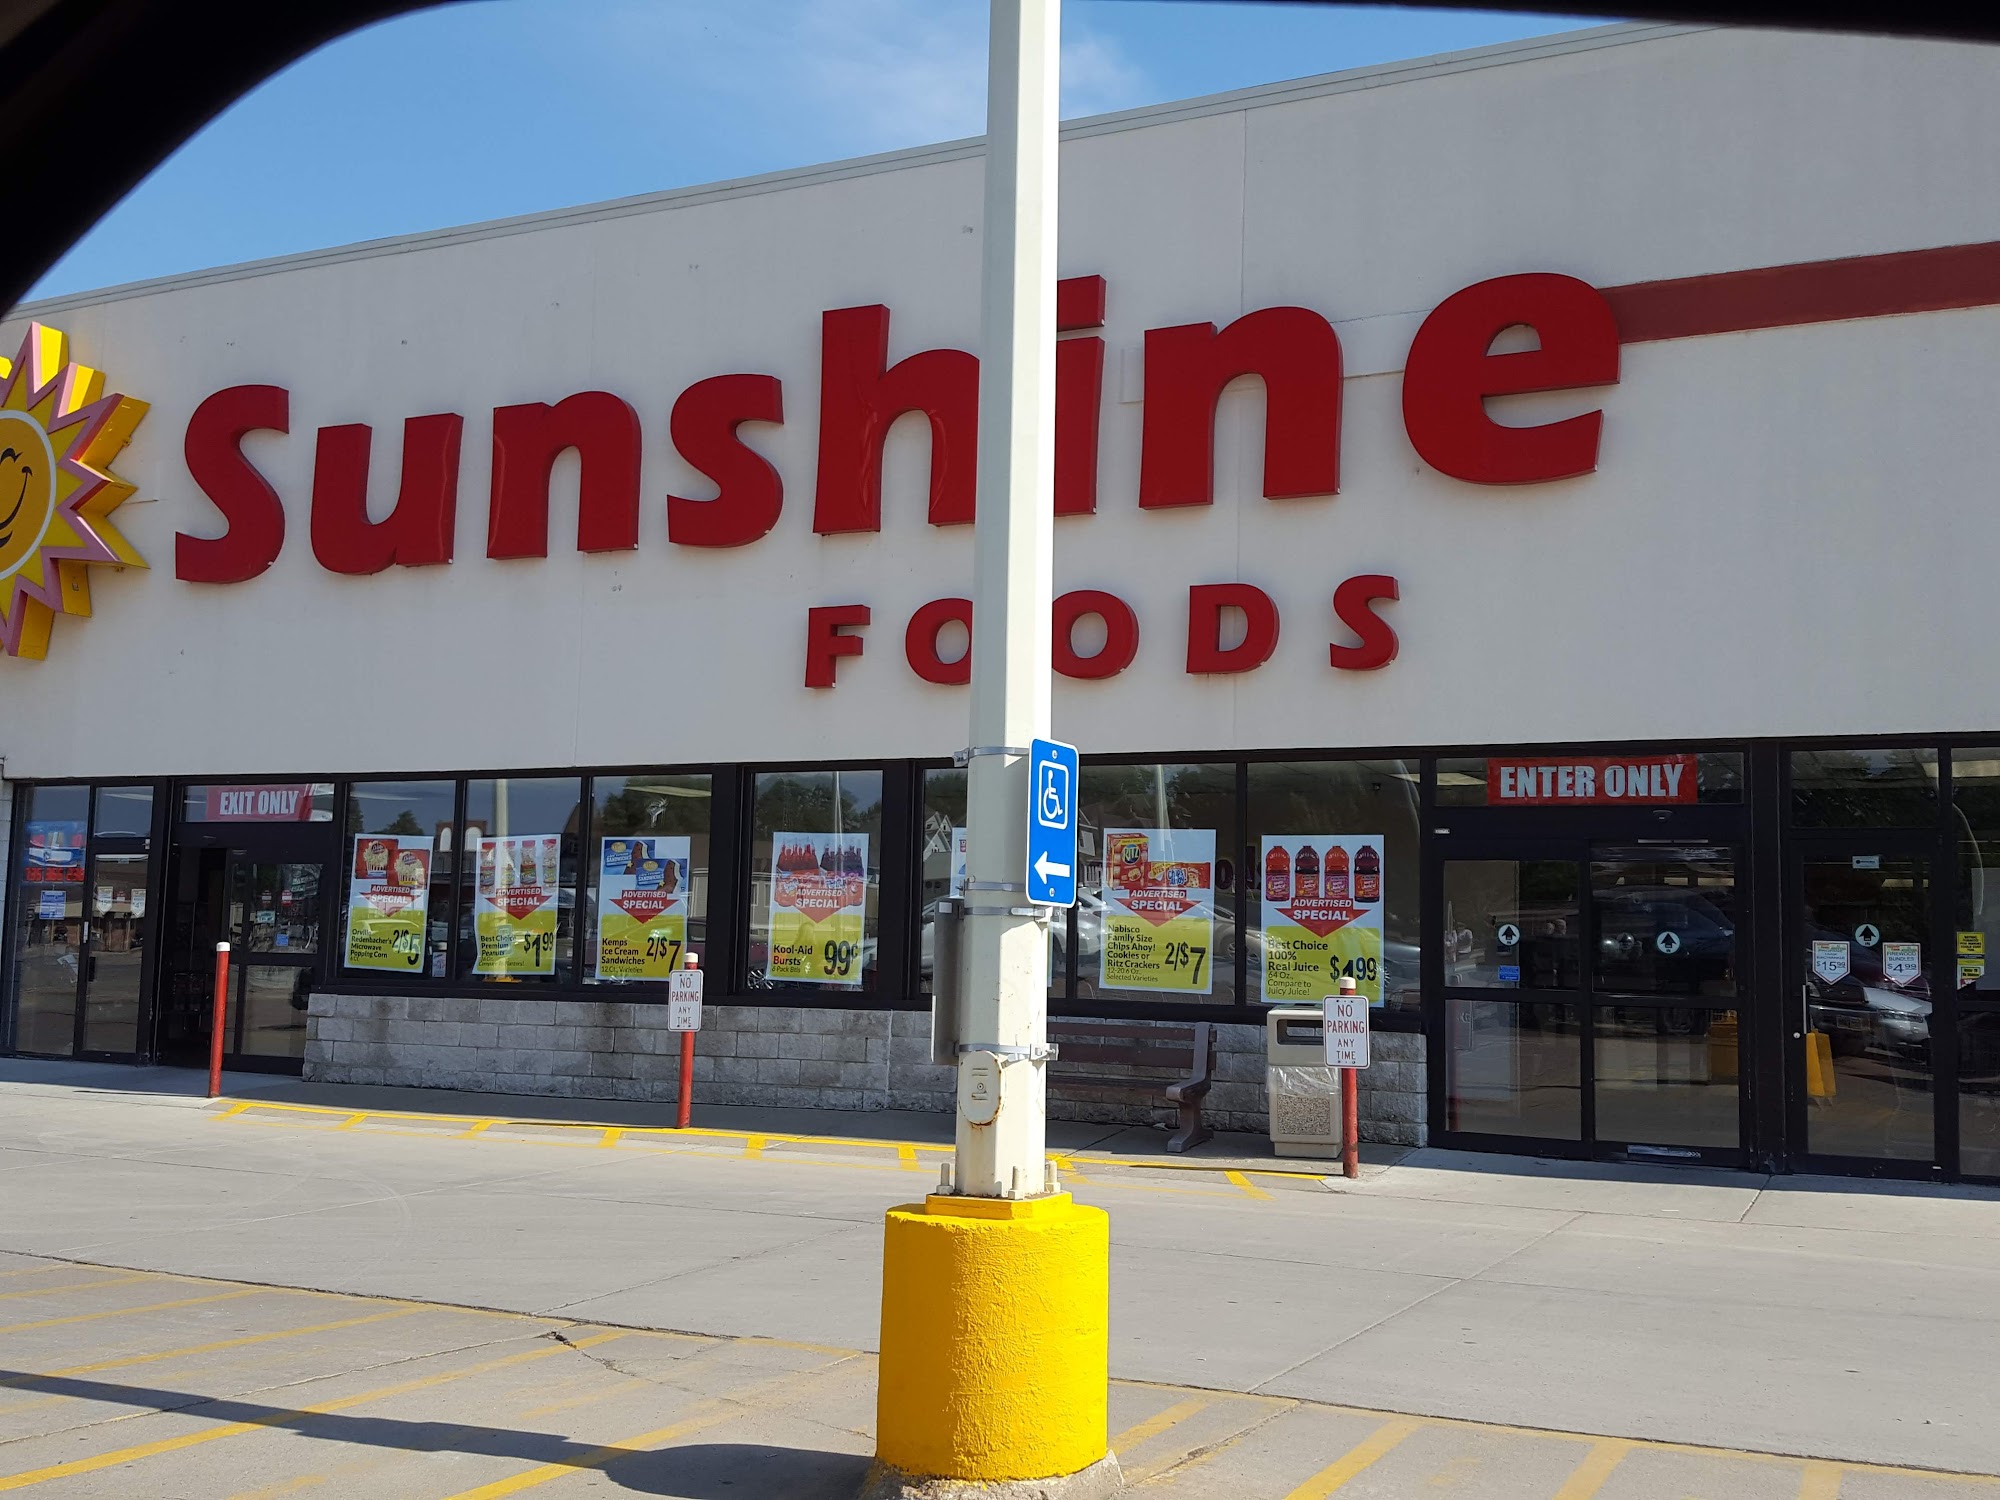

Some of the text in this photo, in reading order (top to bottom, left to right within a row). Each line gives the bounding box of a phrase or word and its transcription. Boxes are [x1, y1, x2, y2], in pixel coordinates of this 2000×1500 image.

[175, 272, 1621, 585] Sunshine
[804, 574, 1400, 690] FOODS
[1500, 763, 1684, 798] ENTER ONLY
[220, 790, 299, 815] EXIT ONLY
[371, 884, 411, 894] ADVERTISED
[497, 888, 541, 896] ADVERTISED
[795, 888, 843, 897] ADVERTISED
[371, 894, 408, 904] SPECIAL
[1130, 890, 1186, 899] ADVERTISED
[497, 897, 540, 906] SPECIAL
[622, 900, 665, 909] SPECIAL
[795, 898, 840, 908] SPECIAL
[1130, 900, 1184, 911] SPECIAL
[1292, 899, 1352, 908] ADVERTISED
[1292, 910, 1350, 921] SPECIAL
[1108, 925, 1140, 933] Nabisco
[602, 938, 628, 948] Kemps
[1107, 934, 1153, 943] Family Size
[351, 943, 382, 951] Microwave
[773, 945, 813, 955] Kool-Aid
[1107, 942, 1156, 953] Chips Ahoy!
[1268, 940, 1328, 950] Best Choice
[373, 951, 388, 959] Corn
[602, 947, 639, 955] Ice Cream
[646, 936, 682, 974] 2/$7
[1107, 951, 1139, 959] Cookies
[1268, 951, 1297, 960] 100%
[601, 956, 645, 965] Sandwiches
[773, 956, 801, 966] Bursts
[1107, 959, 1160, 969] Ritz Crackers
[1164, 941, 1206, 984] 2/$7
[1268, 961, 1319, 972] Real Juice
[679, 977, 692, 988] NO
[1267, 979, 1302, 988] Compare
[672, 991, 699, 1002] PARKING
[1267, 987, 1310, 996] Juicy Juice!
[678, 1006, 691, 1014] ANY
[1337, 1004, 1353, 1018] NO
[677, 1016, 692, 1025] TIME
[1327, 1020, 1365, 1034] PARKING
[1337, 1038, 1355, 1048] ANY
[1336, 1050, 1356, 1060] TIME
